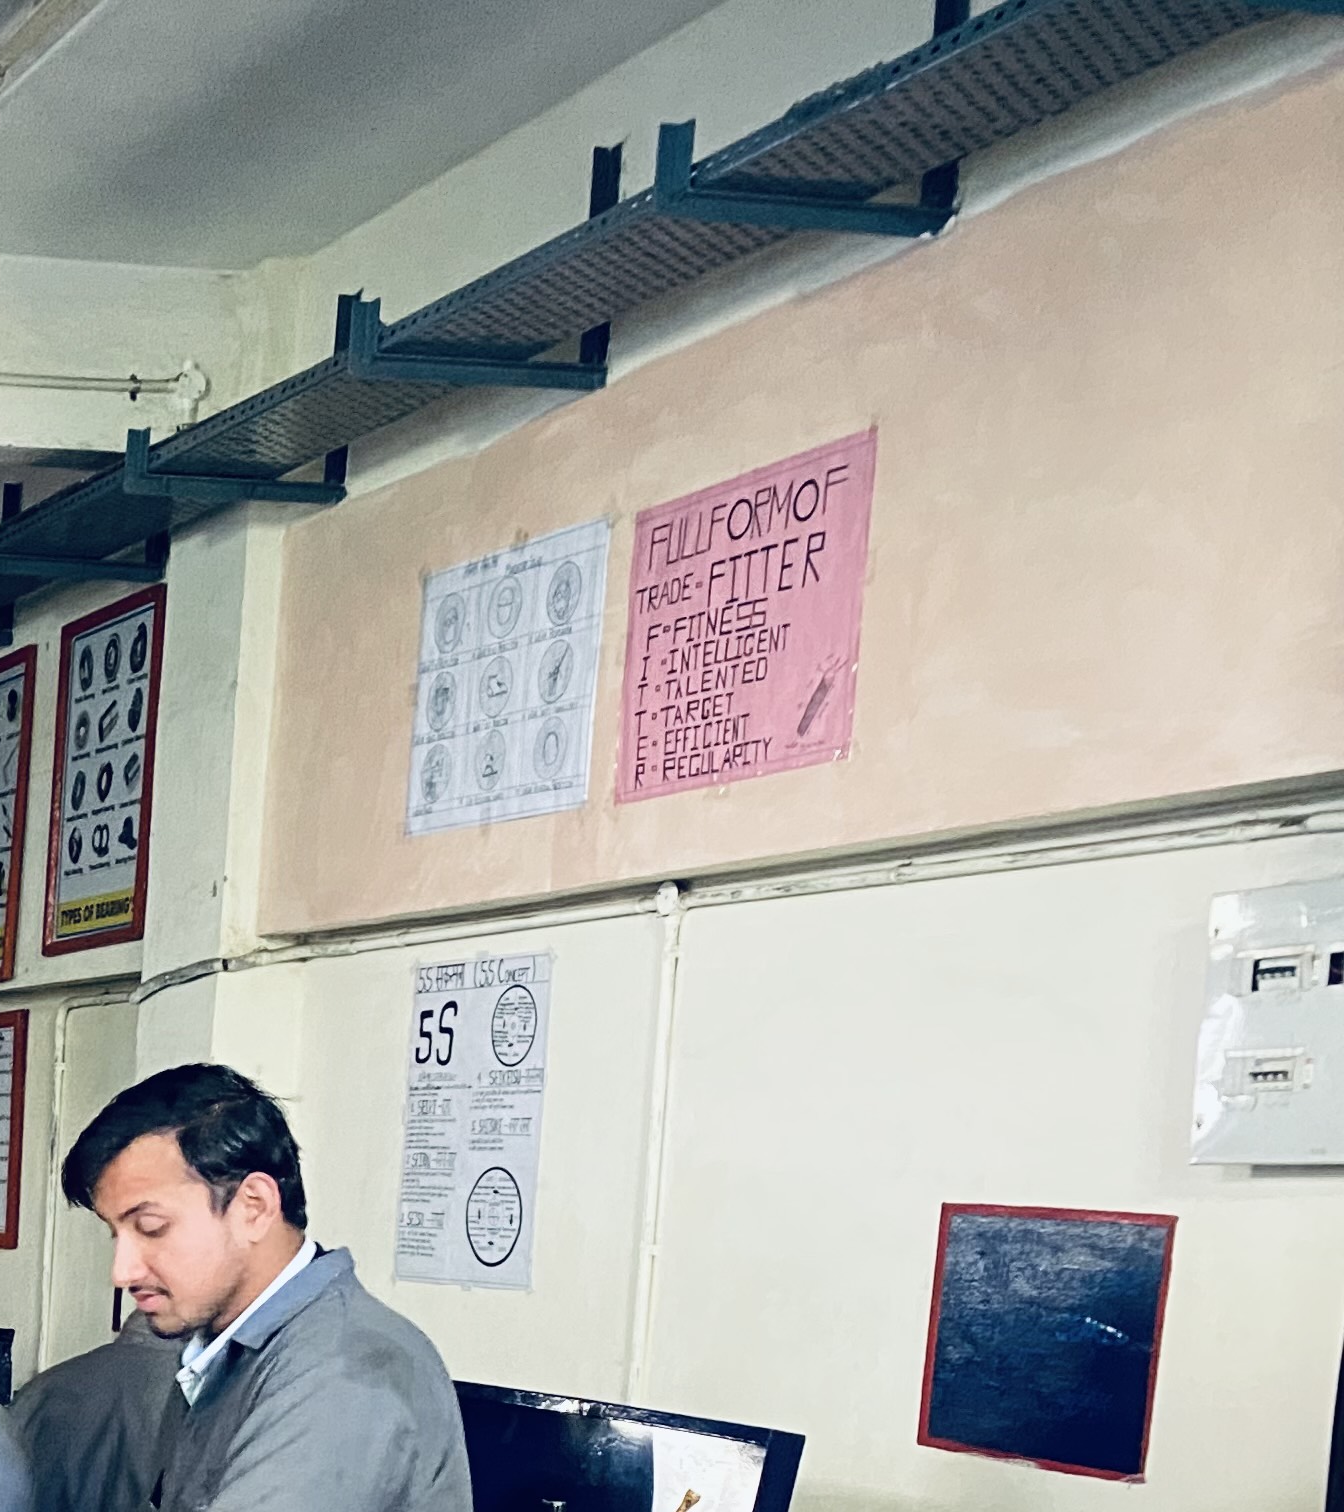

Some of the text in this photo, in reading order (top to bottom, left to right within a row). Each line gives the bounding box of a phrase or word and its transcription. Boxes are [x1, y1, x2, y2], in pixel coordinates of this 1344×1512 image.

[707, 531, 827, 608] FITTER
[673, 597, 769, 645] FITNESS
[667, 623, 791, 676] INTELLIGENT
[665, 656, 769, 701] TALENTED
[660, 692, 735, 728] TARGET
[664, 713, 751, 757] EFFICIENT
[662, 737, 774, 782] REGULARITY
[415, 1000, 458, 1066] 5S
